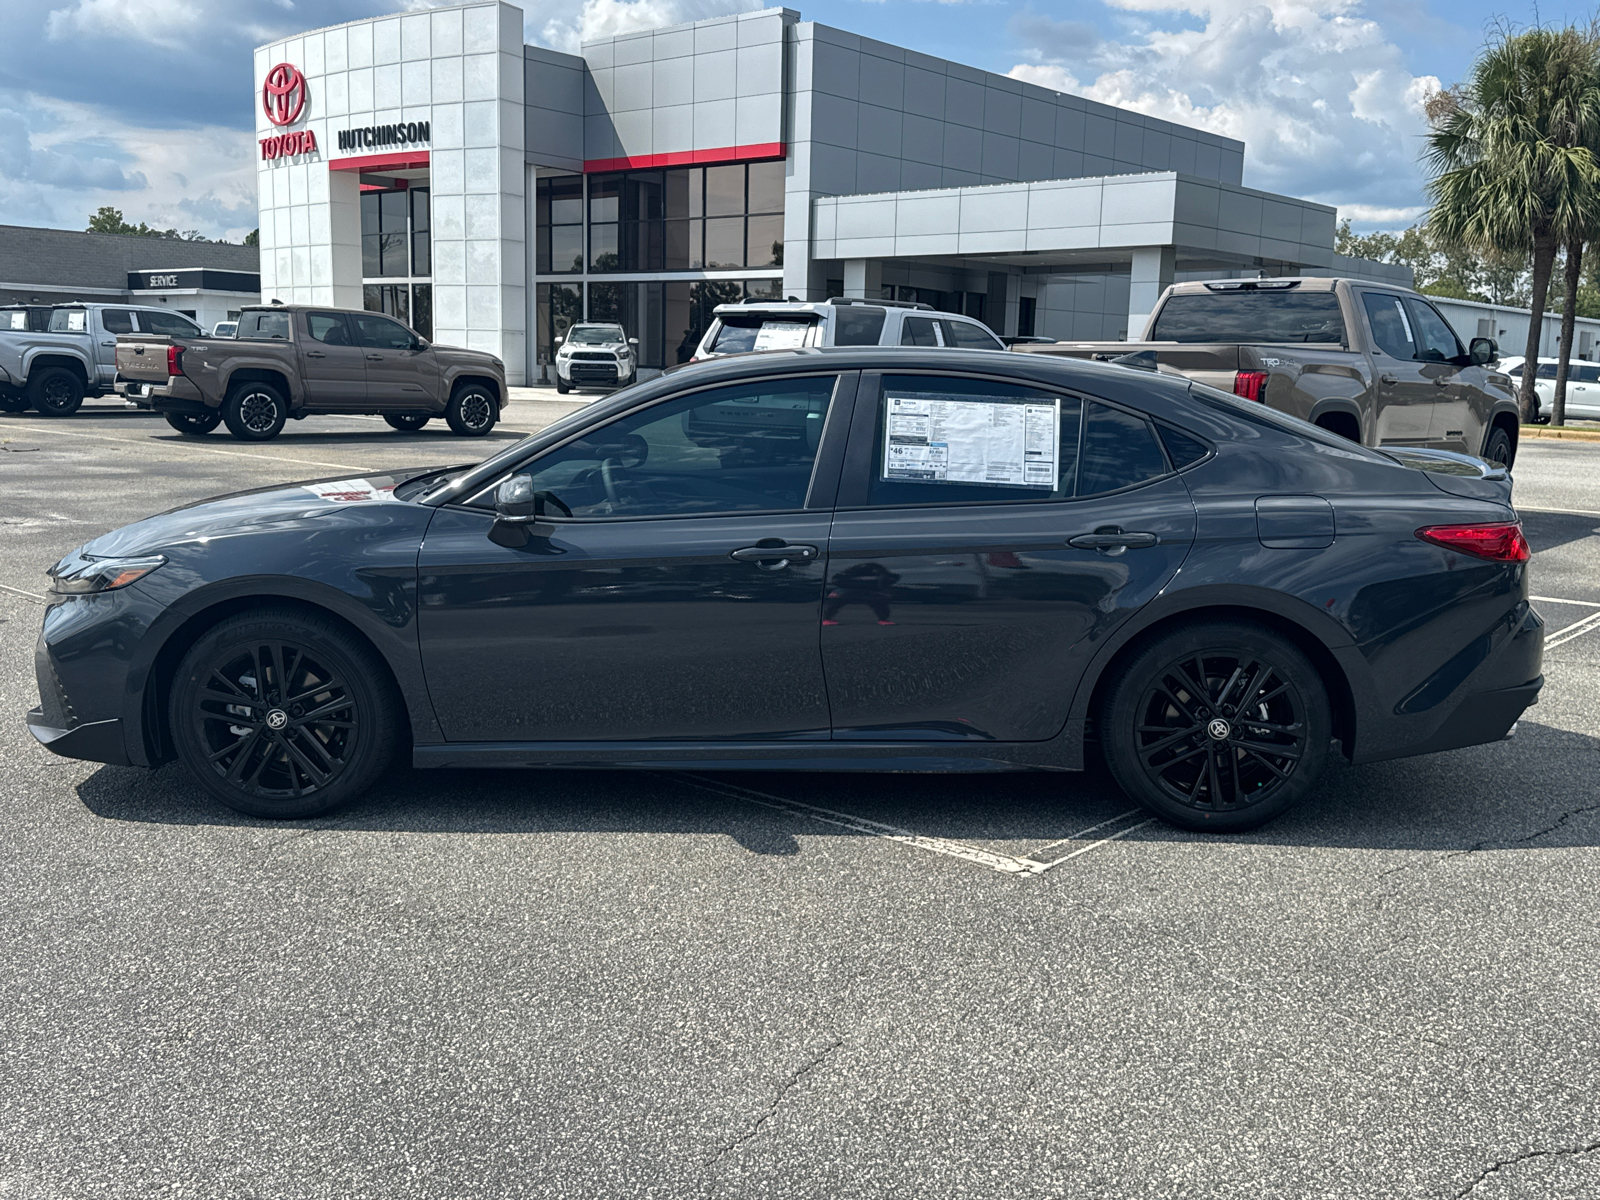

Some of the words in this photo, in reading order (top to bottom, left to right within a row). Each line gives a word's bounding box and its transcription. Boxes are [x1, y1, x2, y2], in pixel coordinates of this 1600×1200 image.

[338, 121, 430, 150] HUTCHINSON
[259, 130, 317, 160] TOYOTA
[150, 274, 178, 287] SERVICE
[123, 362, 159, 370] TACOMA
[1260, 357, 1280, 368] TRD
